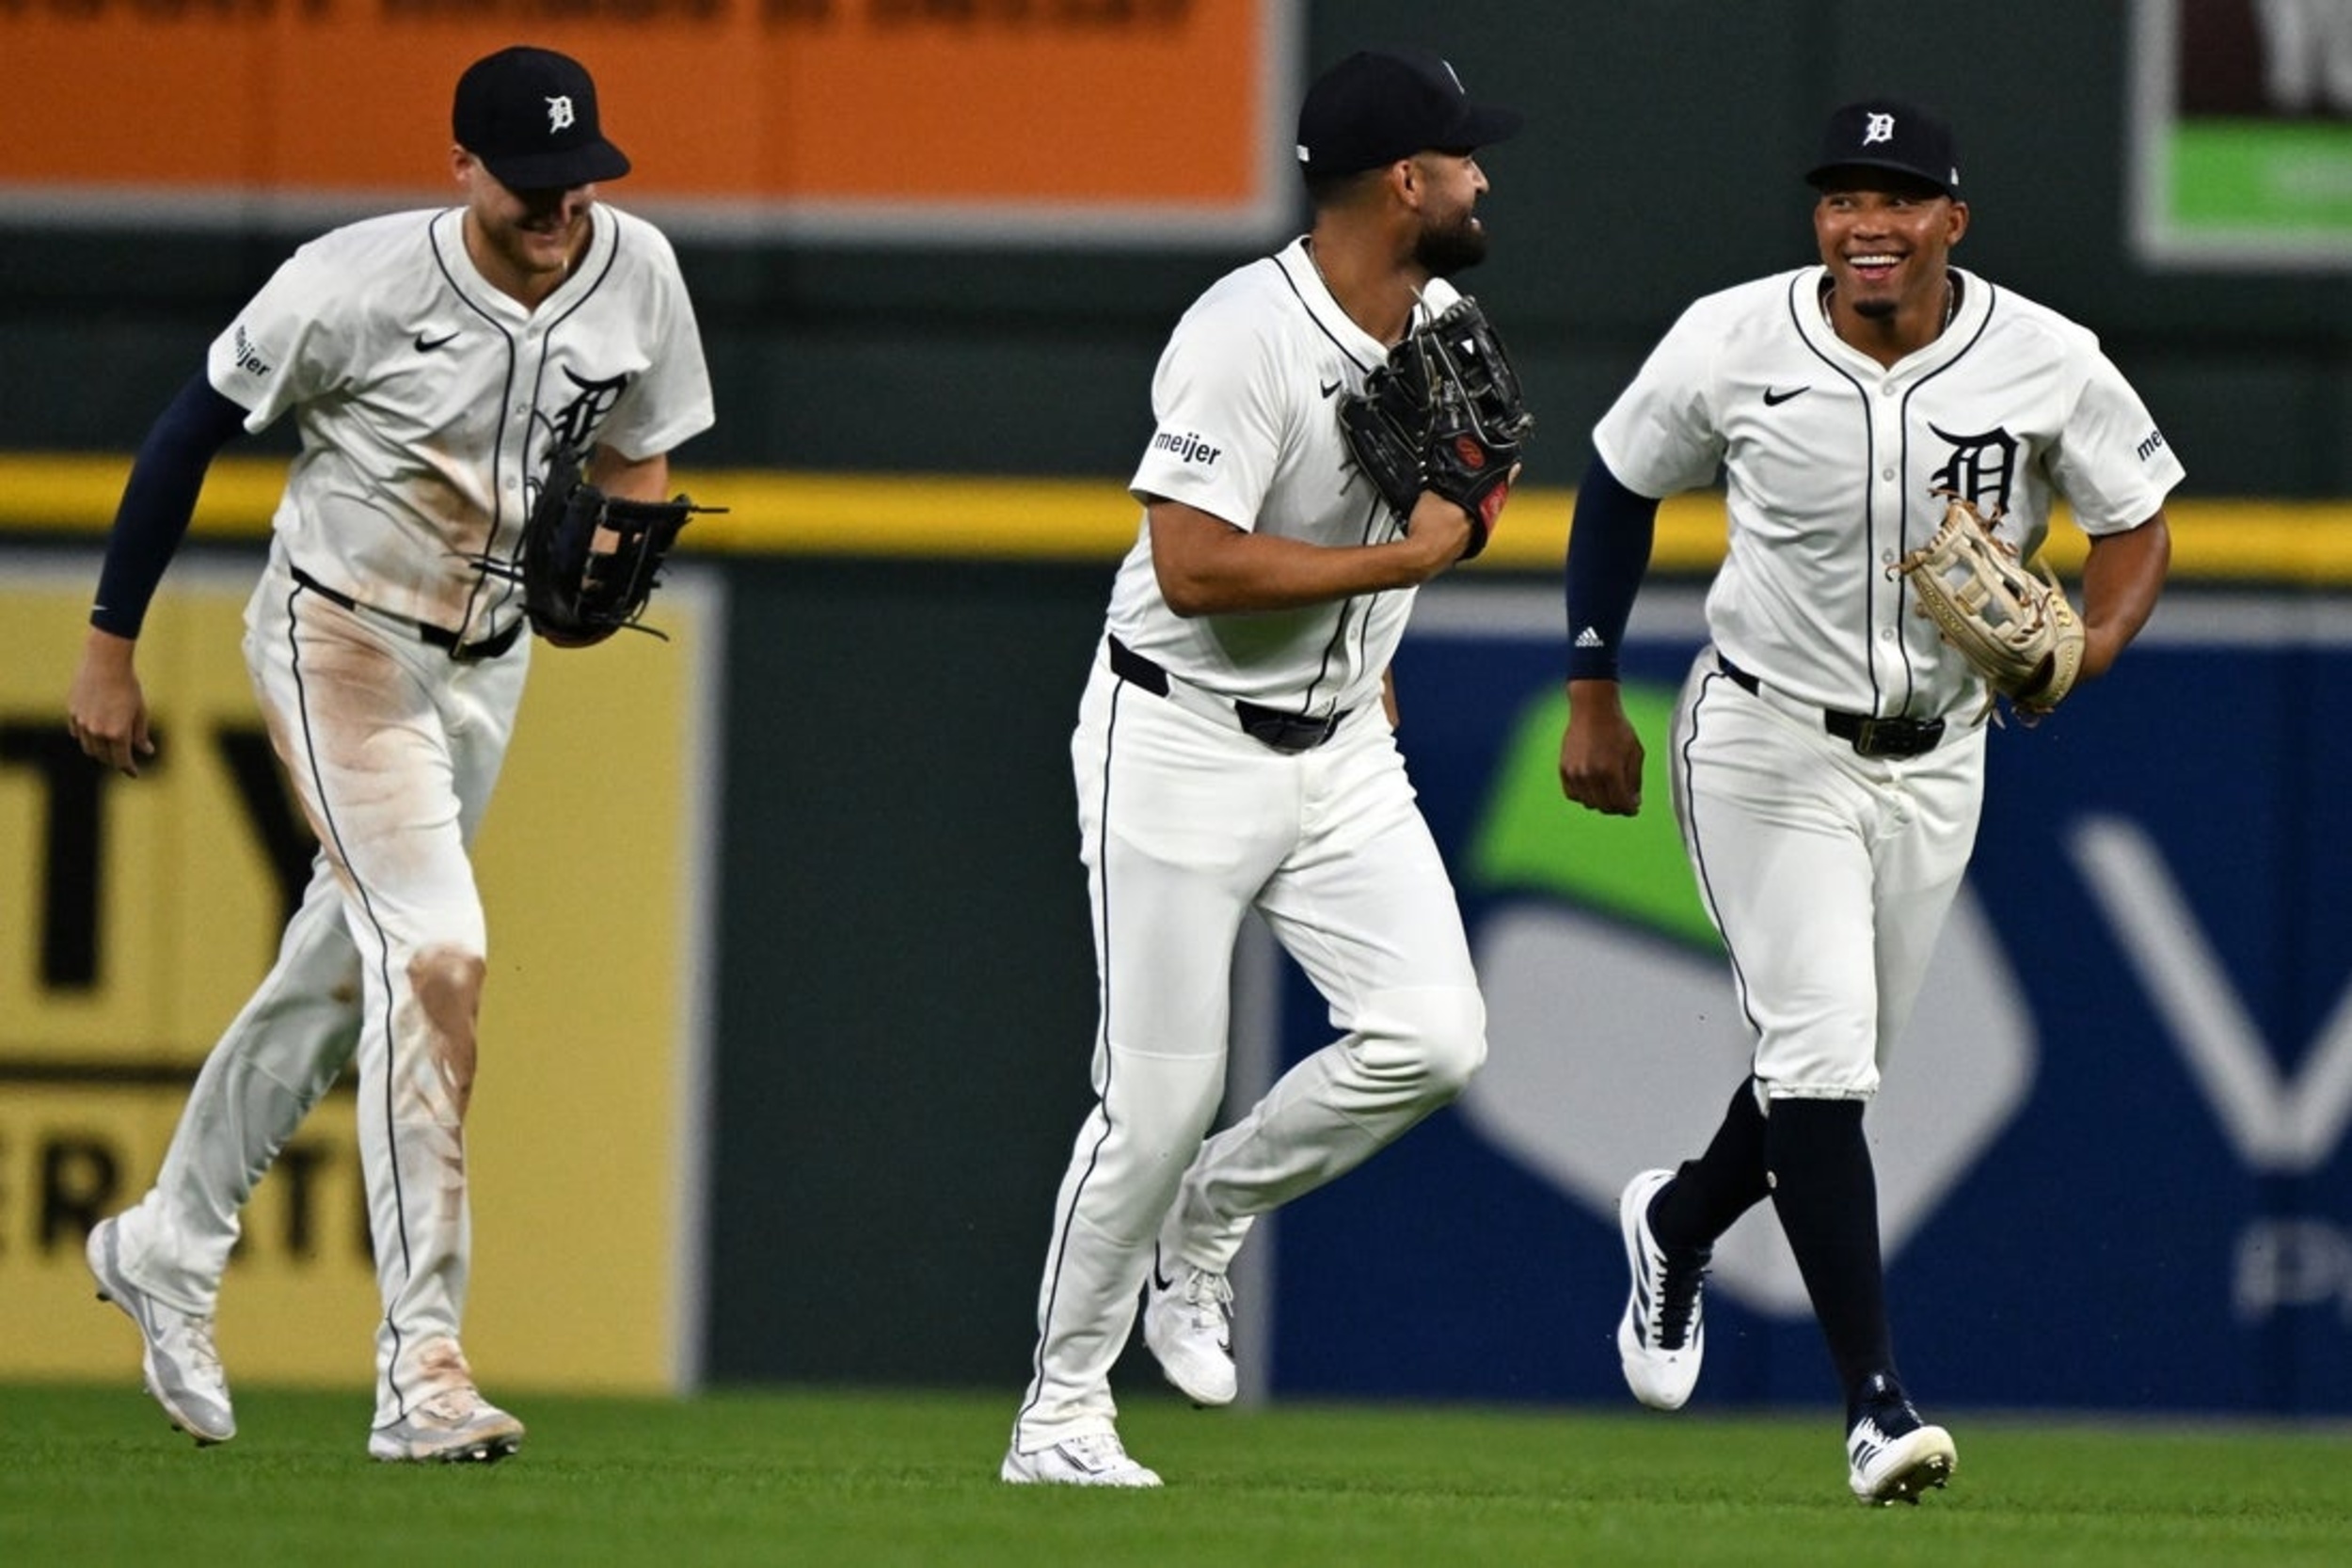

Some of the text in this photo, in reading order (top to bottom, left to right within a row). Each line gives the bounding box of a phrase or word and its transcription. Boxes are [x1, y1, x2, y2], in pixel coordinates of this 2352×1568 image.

[545, 96, 575, 134] D
[1863, 112, 1895, 146] D
[1154, 433, 1221, 466] meijer
